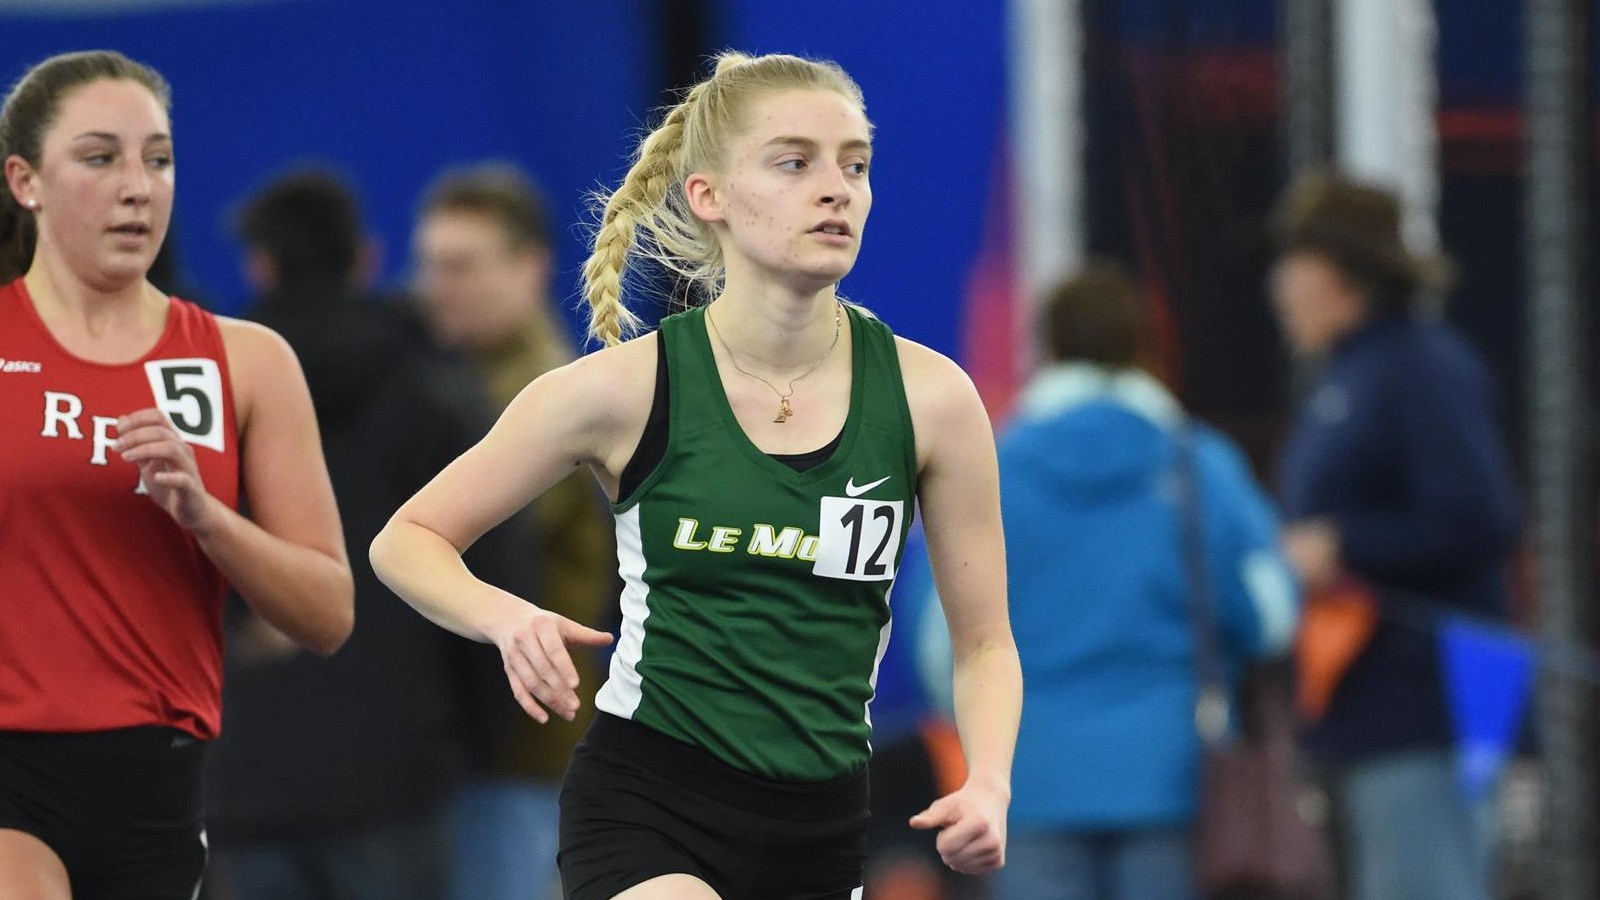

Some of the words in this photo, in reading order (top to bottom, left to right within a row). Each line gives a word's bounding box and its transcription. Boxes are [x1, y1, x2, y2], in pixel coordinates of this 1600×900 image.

[161, 366, 212, 436] 5
[673, 517, 742, 552] LE
[840, 504, 894, 576] 12
